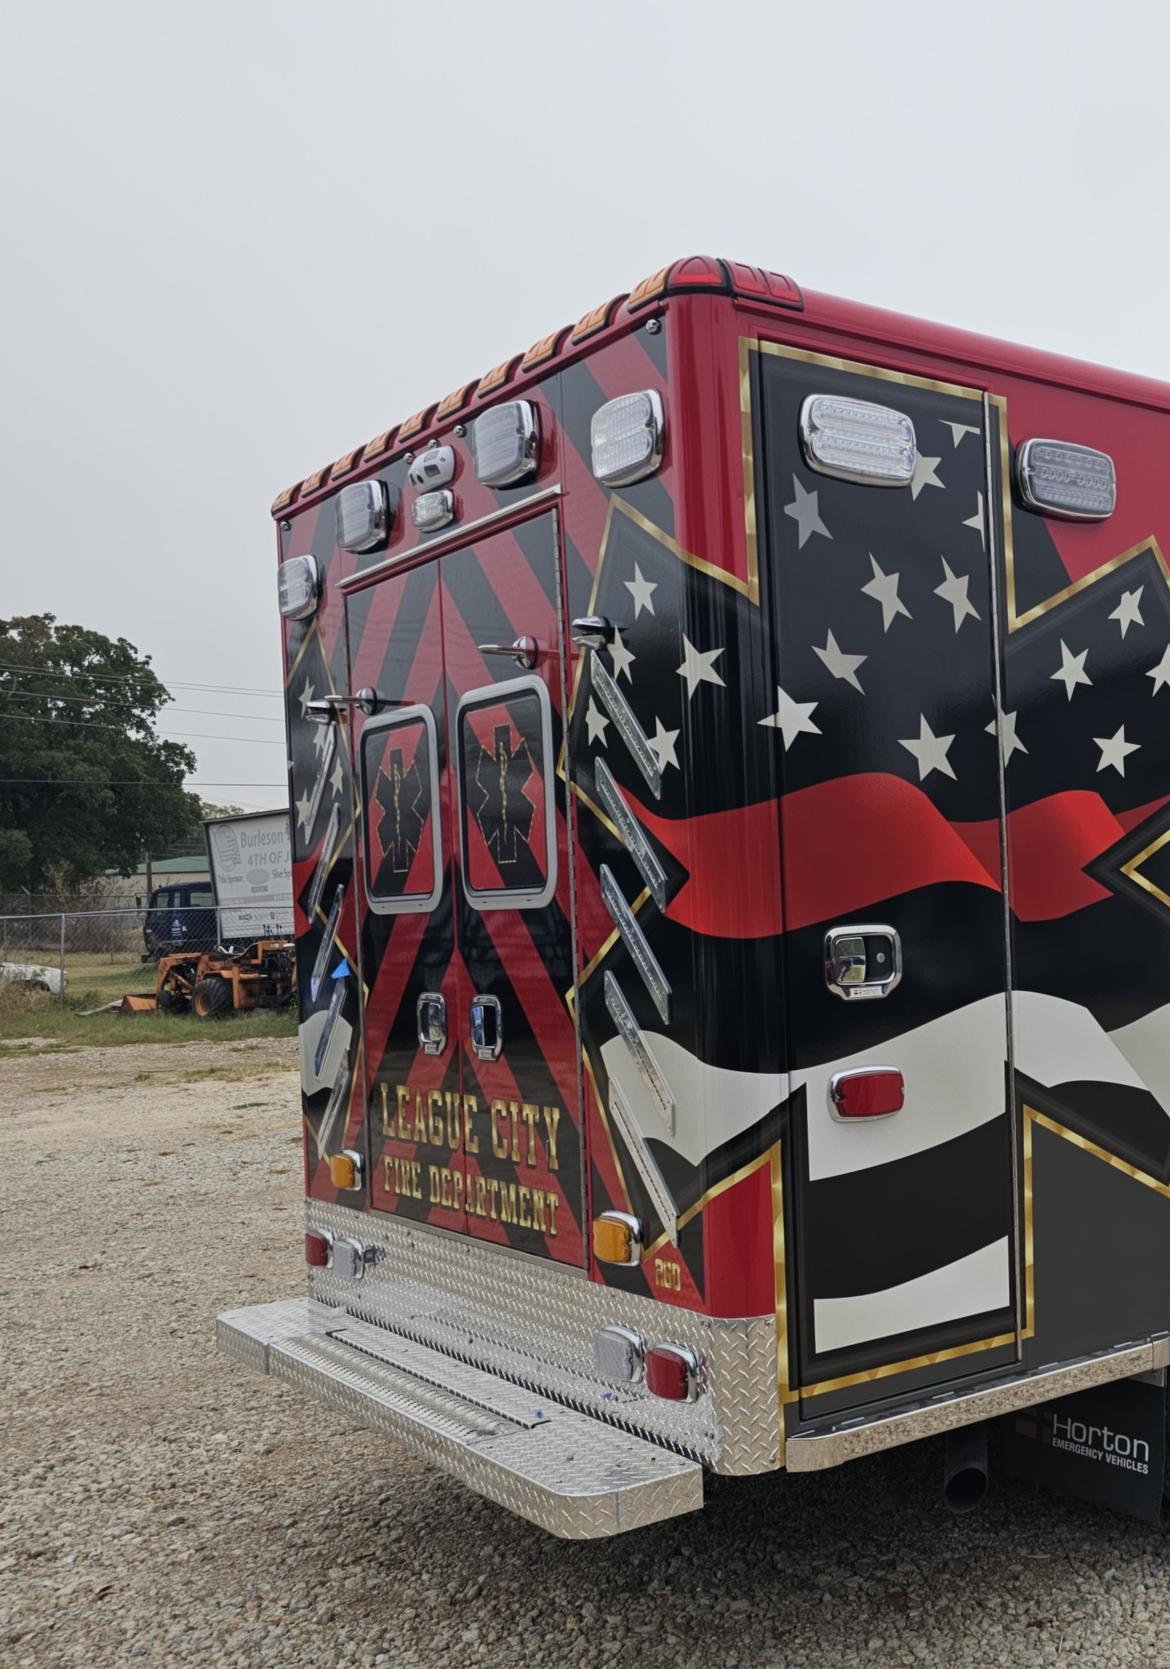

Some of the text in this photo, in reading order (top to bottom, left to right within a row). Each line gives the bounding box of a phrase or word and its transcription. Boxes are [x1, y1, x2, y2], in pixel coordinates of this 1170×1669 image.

[240, 828, 284, 848] Burleson
[248, 852, 267, 867] 4TH
[269, 852, 283, 864] OF
[380, 1082, 561, 1170] LEAGUE CITY
[383, 1155, 560, 1236] FIRE DEPARTMENT
[1052, 1413, 1150, 1462] Horton
[1052, 1437, 1149, 1475] EMERGENCY VEHICLES
